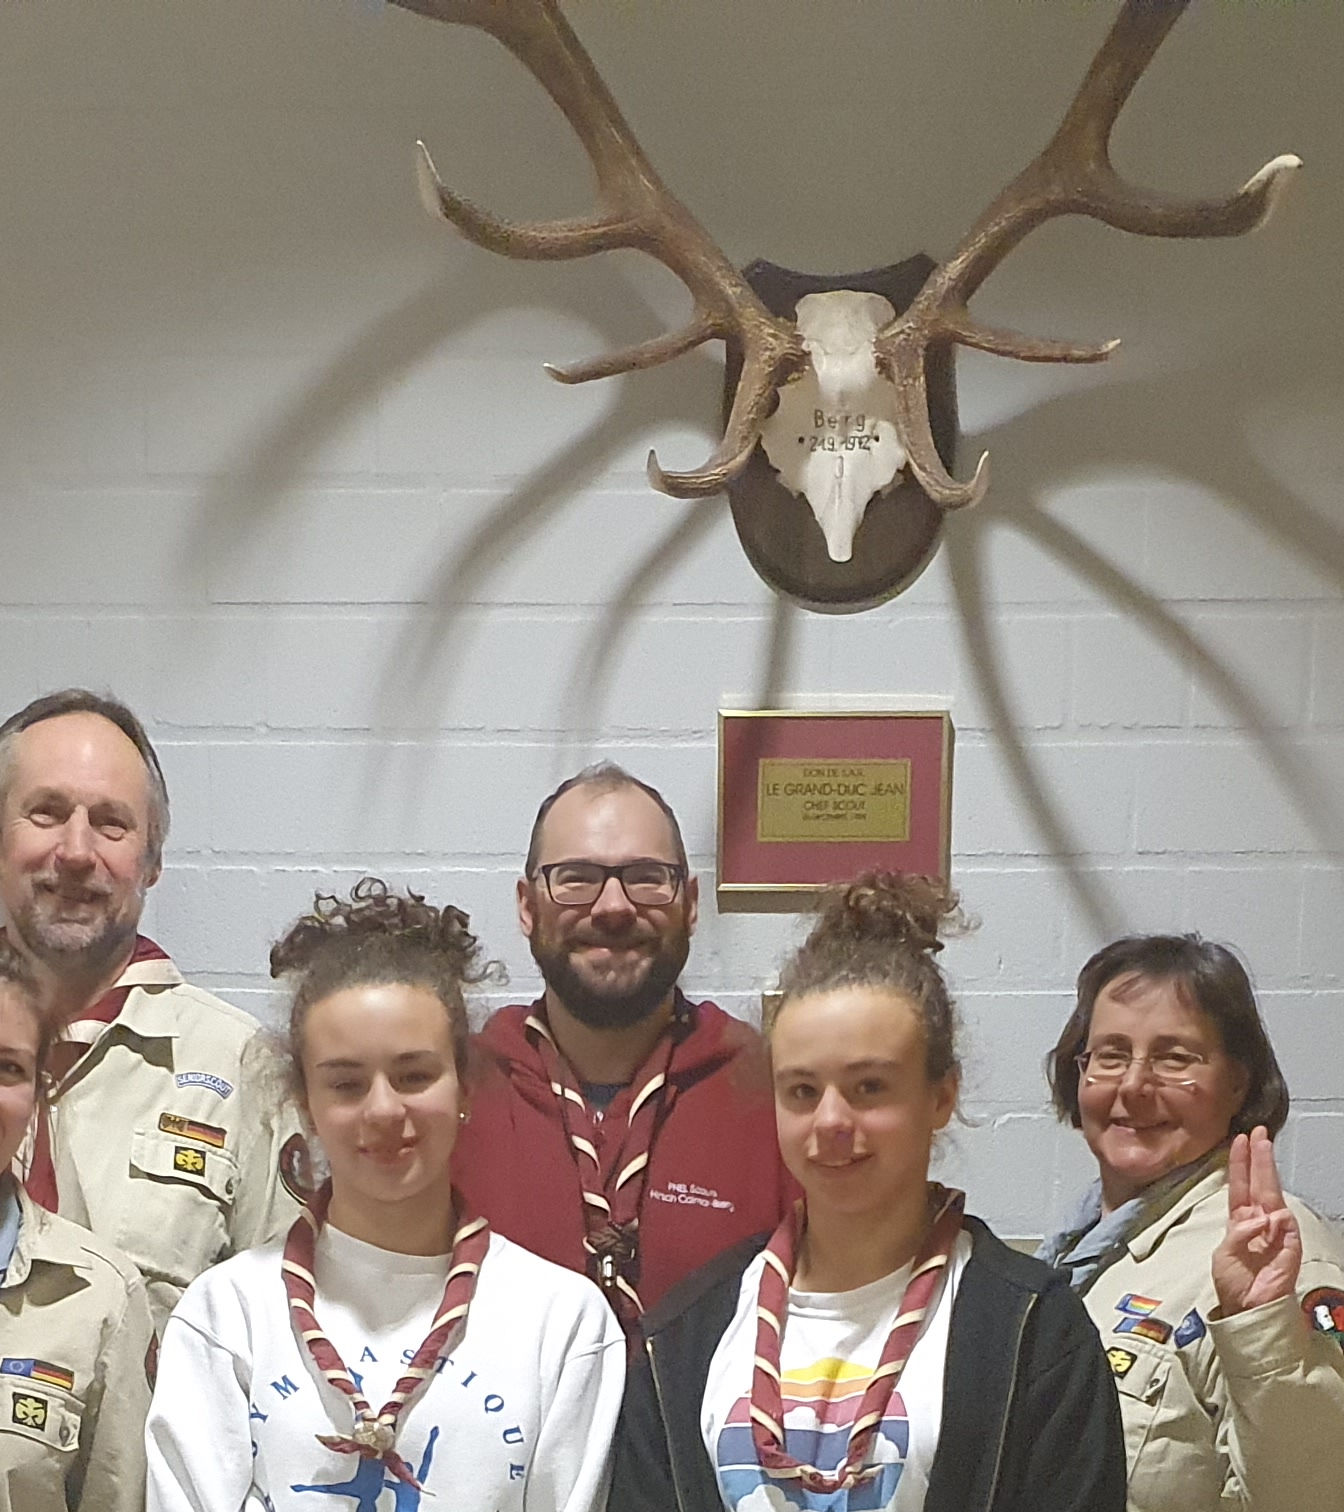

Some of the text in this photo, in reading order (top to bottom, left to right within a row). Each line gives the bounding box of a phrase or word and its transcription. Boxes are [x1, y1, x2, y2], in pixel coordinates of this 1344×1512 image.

[814, 409, 865, 432] Berg
[766, 783, 904, 797] LE GRAND-DUC JEAN
[804, 801, 866, 812] CHEF SCOUT
